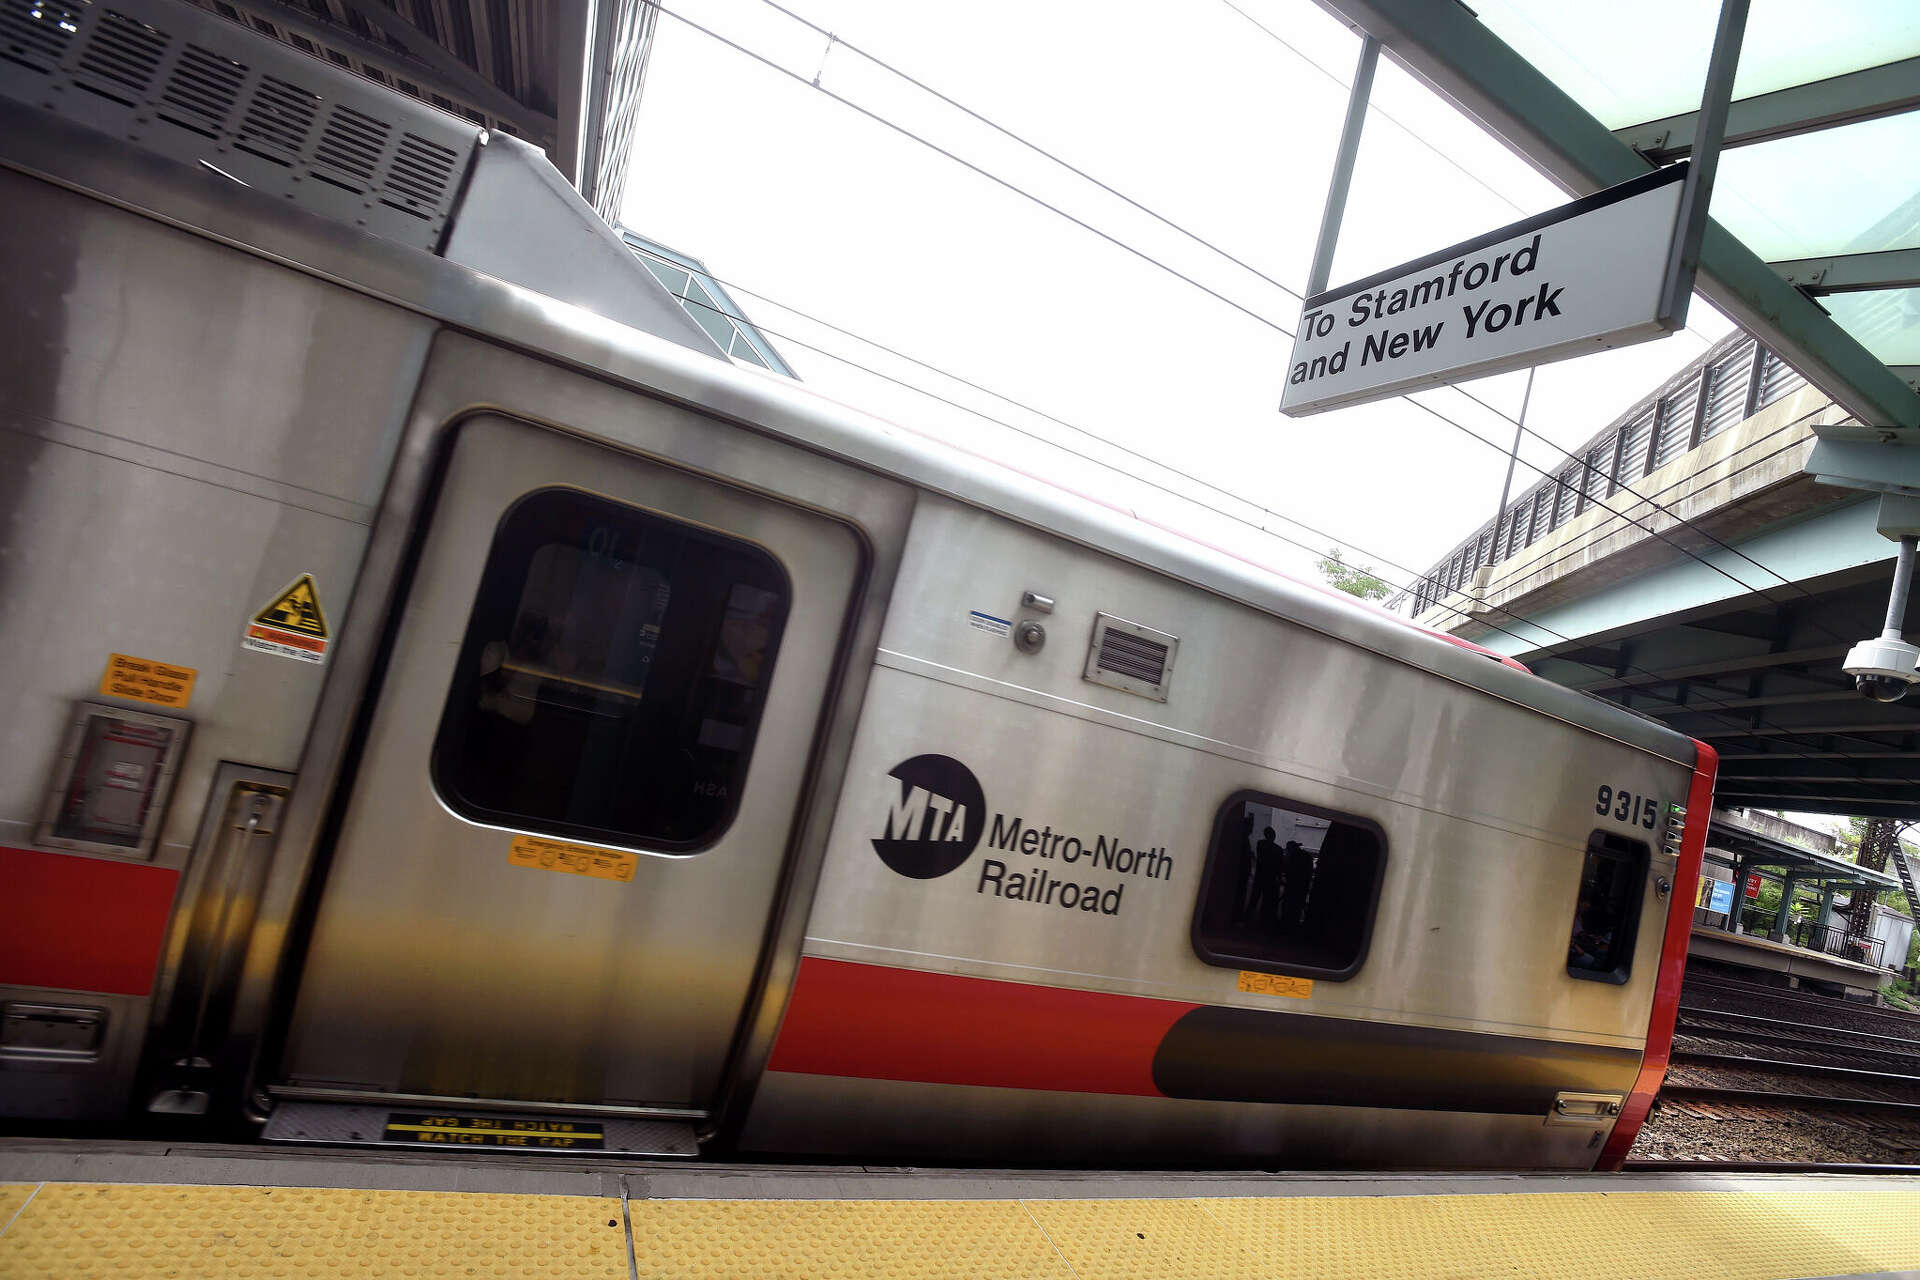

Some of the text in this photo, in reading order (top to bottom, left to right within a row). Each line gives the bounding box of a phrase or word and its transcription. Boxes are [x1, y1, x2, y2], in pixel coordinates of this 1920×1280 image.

[1304, 234, 1542, 341] To Stamford
[1290, 282, 1566, 385] and New York
[872, 774, 969, 842] MTA
[1595, 784, 1658, 829] 9315
[988, 814, 1174, 880] Metro-North
[977, 859, 1125, 916] Railroad
[417, 1132, 484, 1145] WATCH
[495, 1135, 528, 1146] THE
